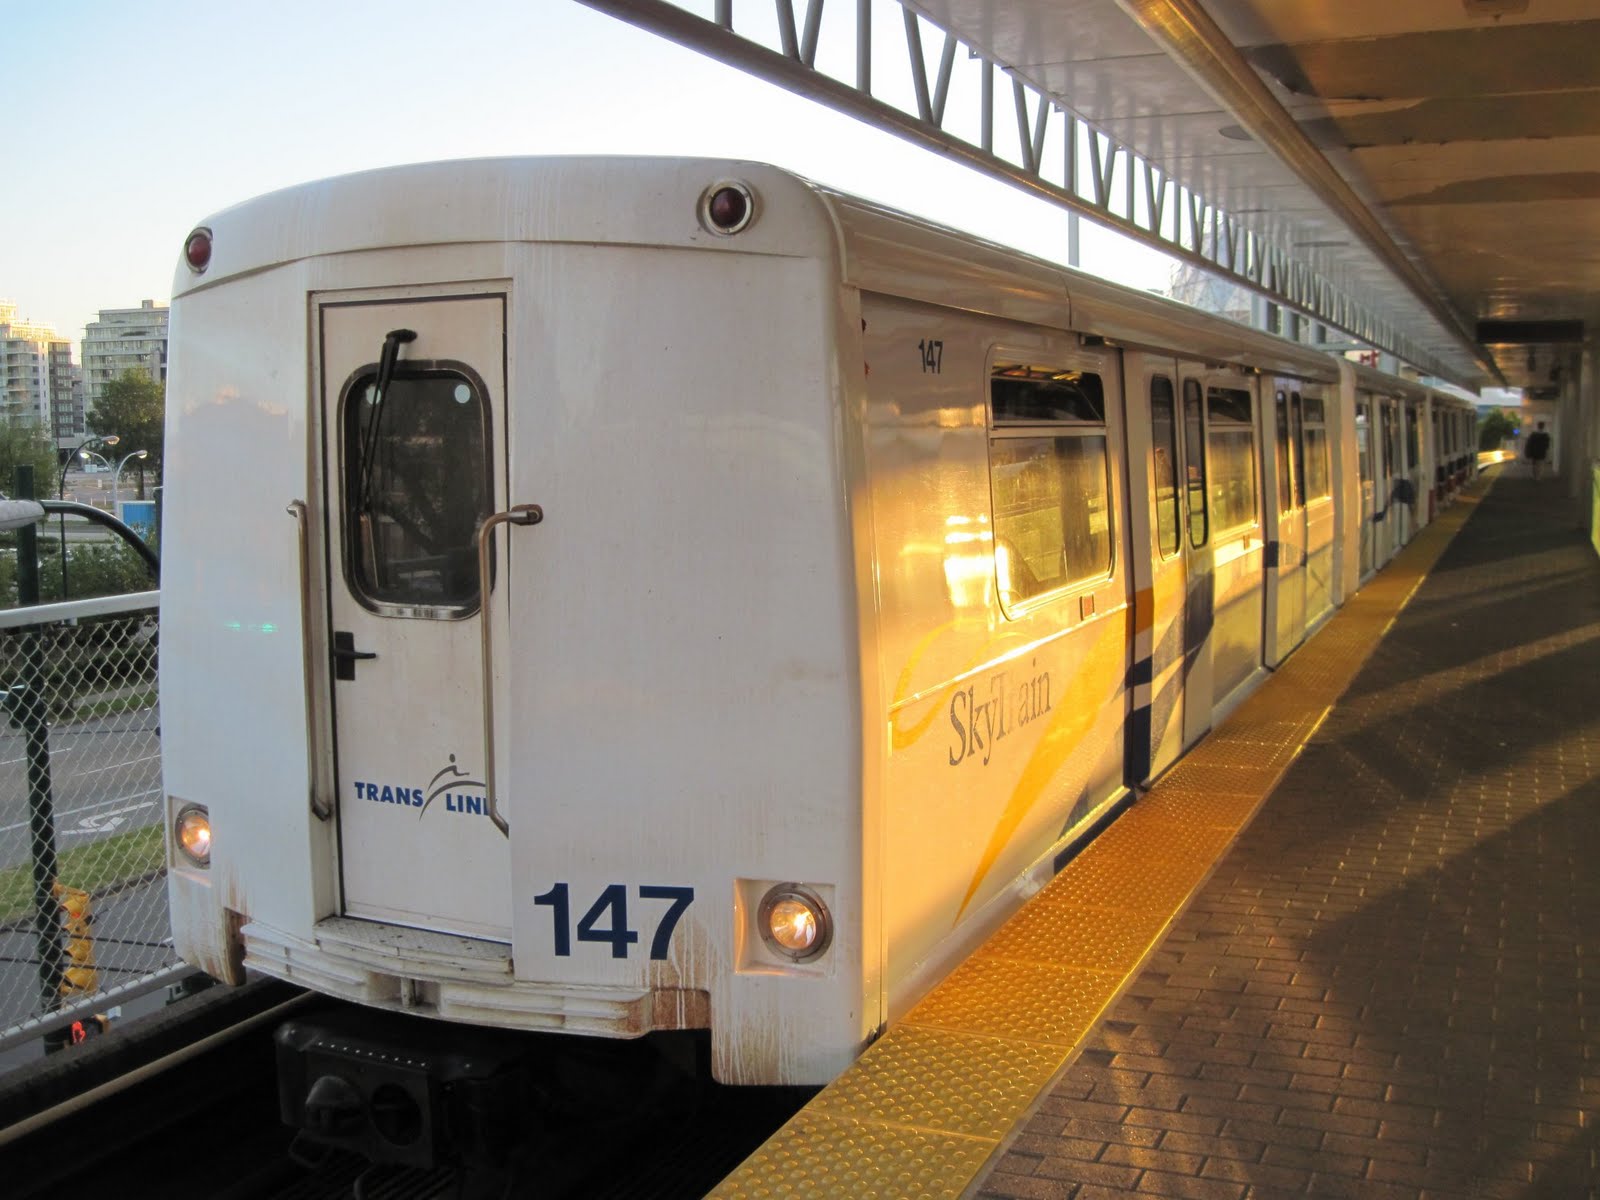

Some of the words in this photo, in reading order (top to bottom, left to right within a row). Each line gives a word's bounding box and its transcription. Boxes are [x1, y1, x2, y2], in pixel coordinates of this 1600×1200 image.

[918, 339, 944, 374] 147
[354, 781, 424, 807] TRANS
[533, 882, 695, 961] 147
